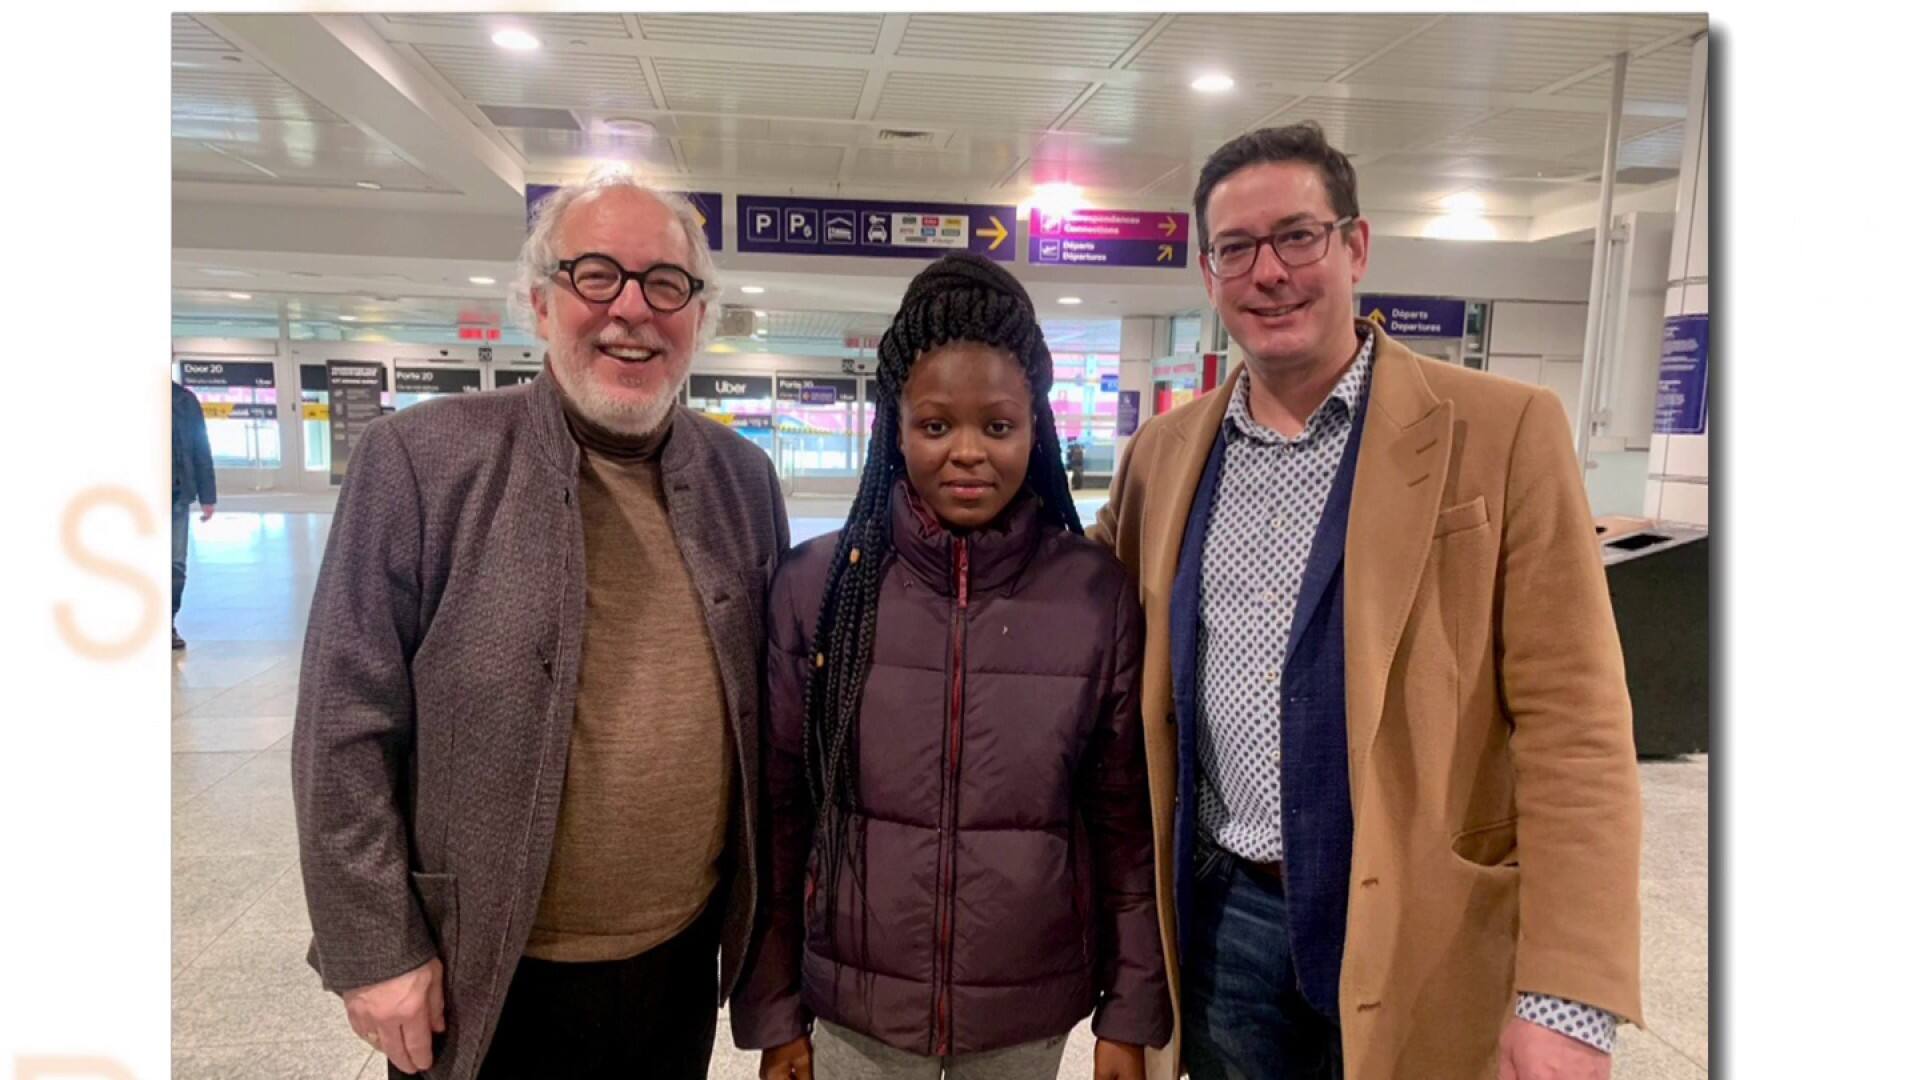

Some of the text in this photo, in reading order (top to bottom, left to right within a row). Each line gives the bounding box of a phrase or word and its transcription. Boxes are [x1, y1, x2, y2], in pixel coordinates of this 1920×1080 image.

[756, 213, 772, 234] P
[1391, 308, 1429, 320] Départs
[1391, 321, 1442, 333] Departures
[183, 363, 224, 374] Door 20
[396, 371, 434, 381] Porte 20
[715, 380, 747, 395] Uber
